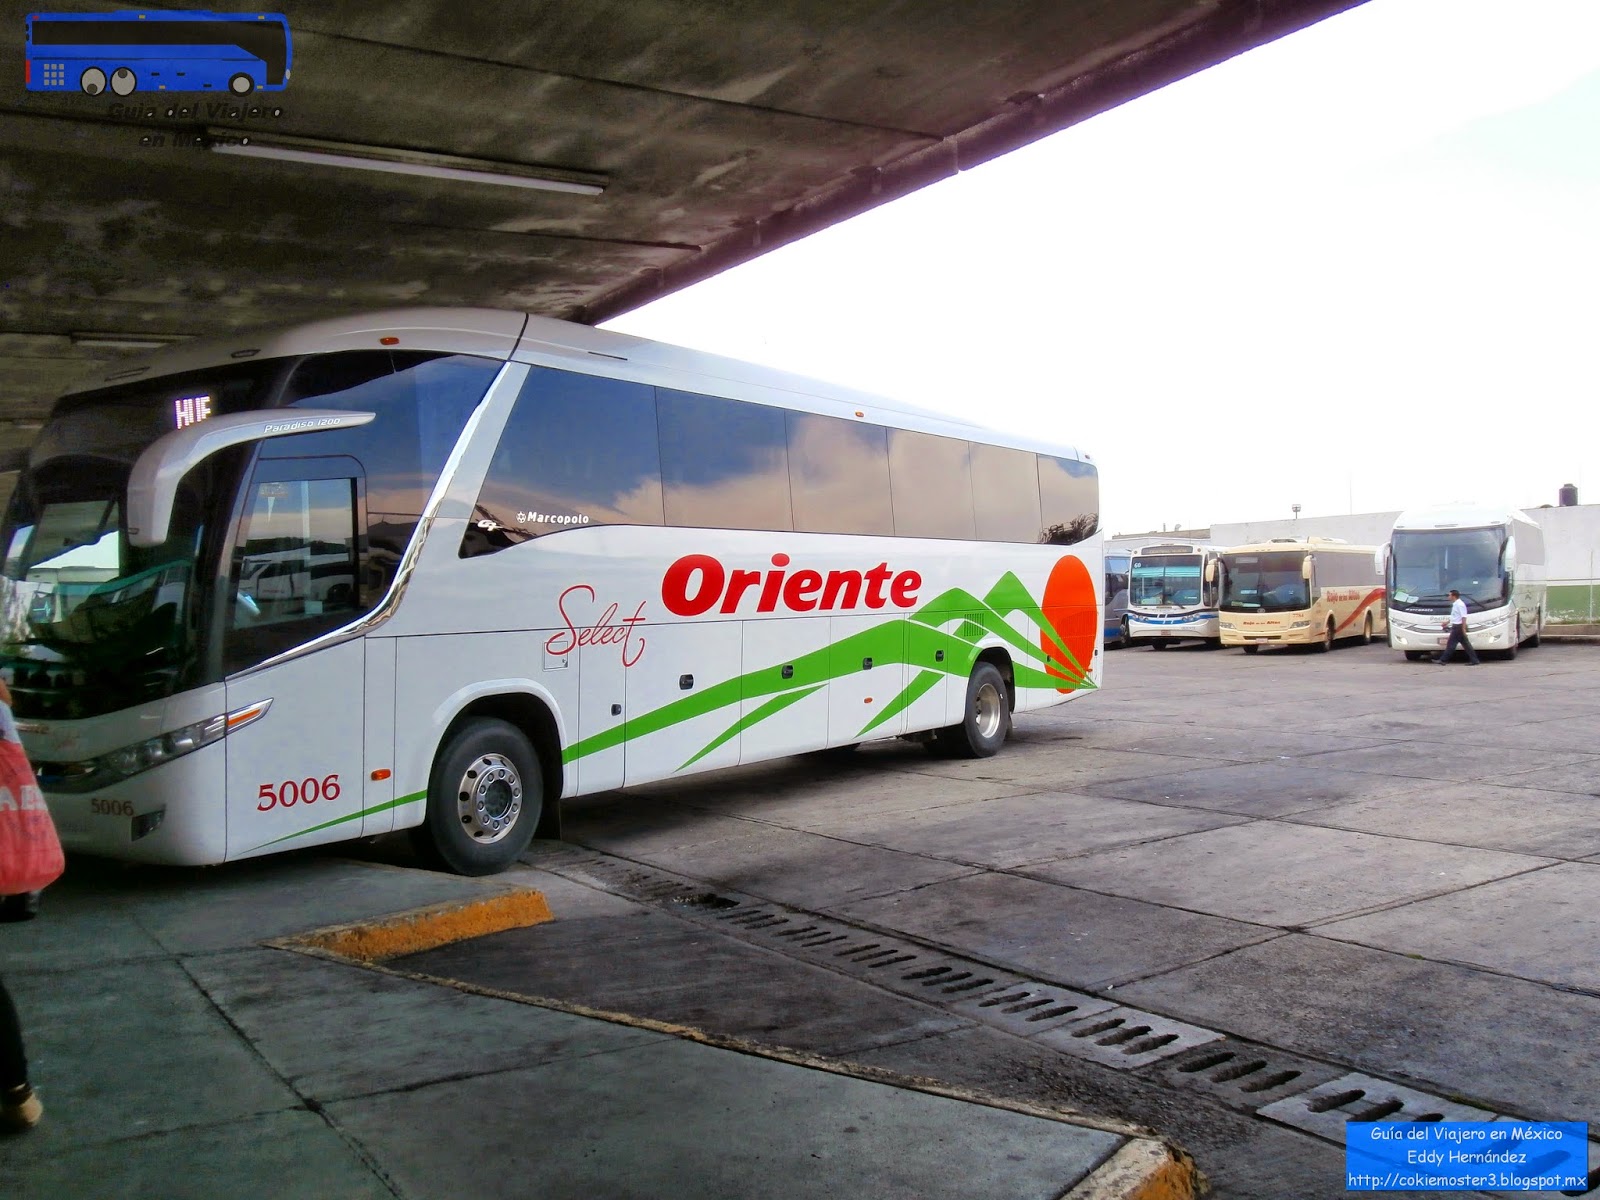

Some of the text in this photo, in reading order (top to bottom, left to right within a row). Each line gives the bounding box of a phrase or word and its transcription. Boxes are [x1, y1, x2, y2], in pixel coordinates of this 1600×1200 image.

[263, 417, 341, 434] Paradiso 1200
[527, 511, 589, 526] Marcopolo
[661, 552, 923, 617] Oriente
[545, 584, 647, 668] Select
[91, 798, 134, 816] 5006
[257, 774, 341, 812] 5006
